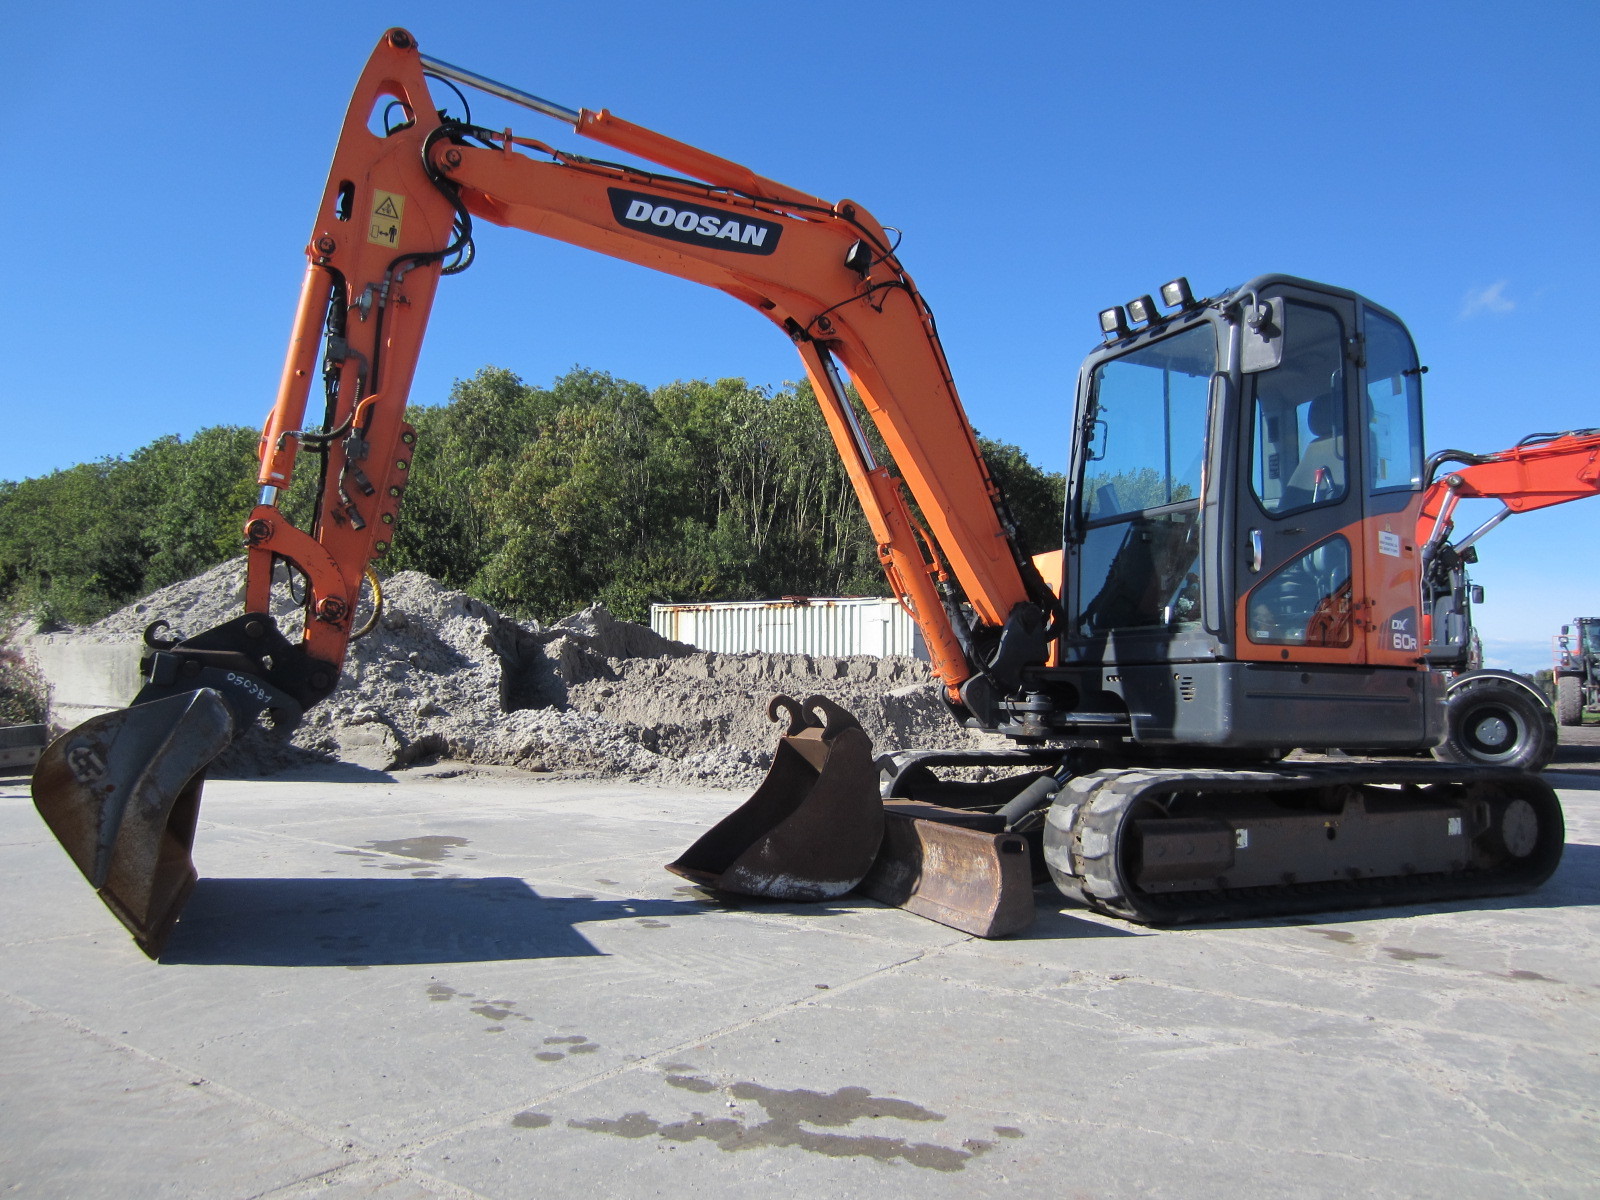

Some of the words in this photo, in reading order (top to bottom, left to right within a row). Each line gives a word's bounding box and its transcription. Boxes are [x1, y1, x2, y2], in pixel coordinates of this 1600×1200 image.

[625, 200, 767, 246] DOOSAN
[1391, 618, 1408, 630] DX
[1393, 633, 1417, 649] 60R
